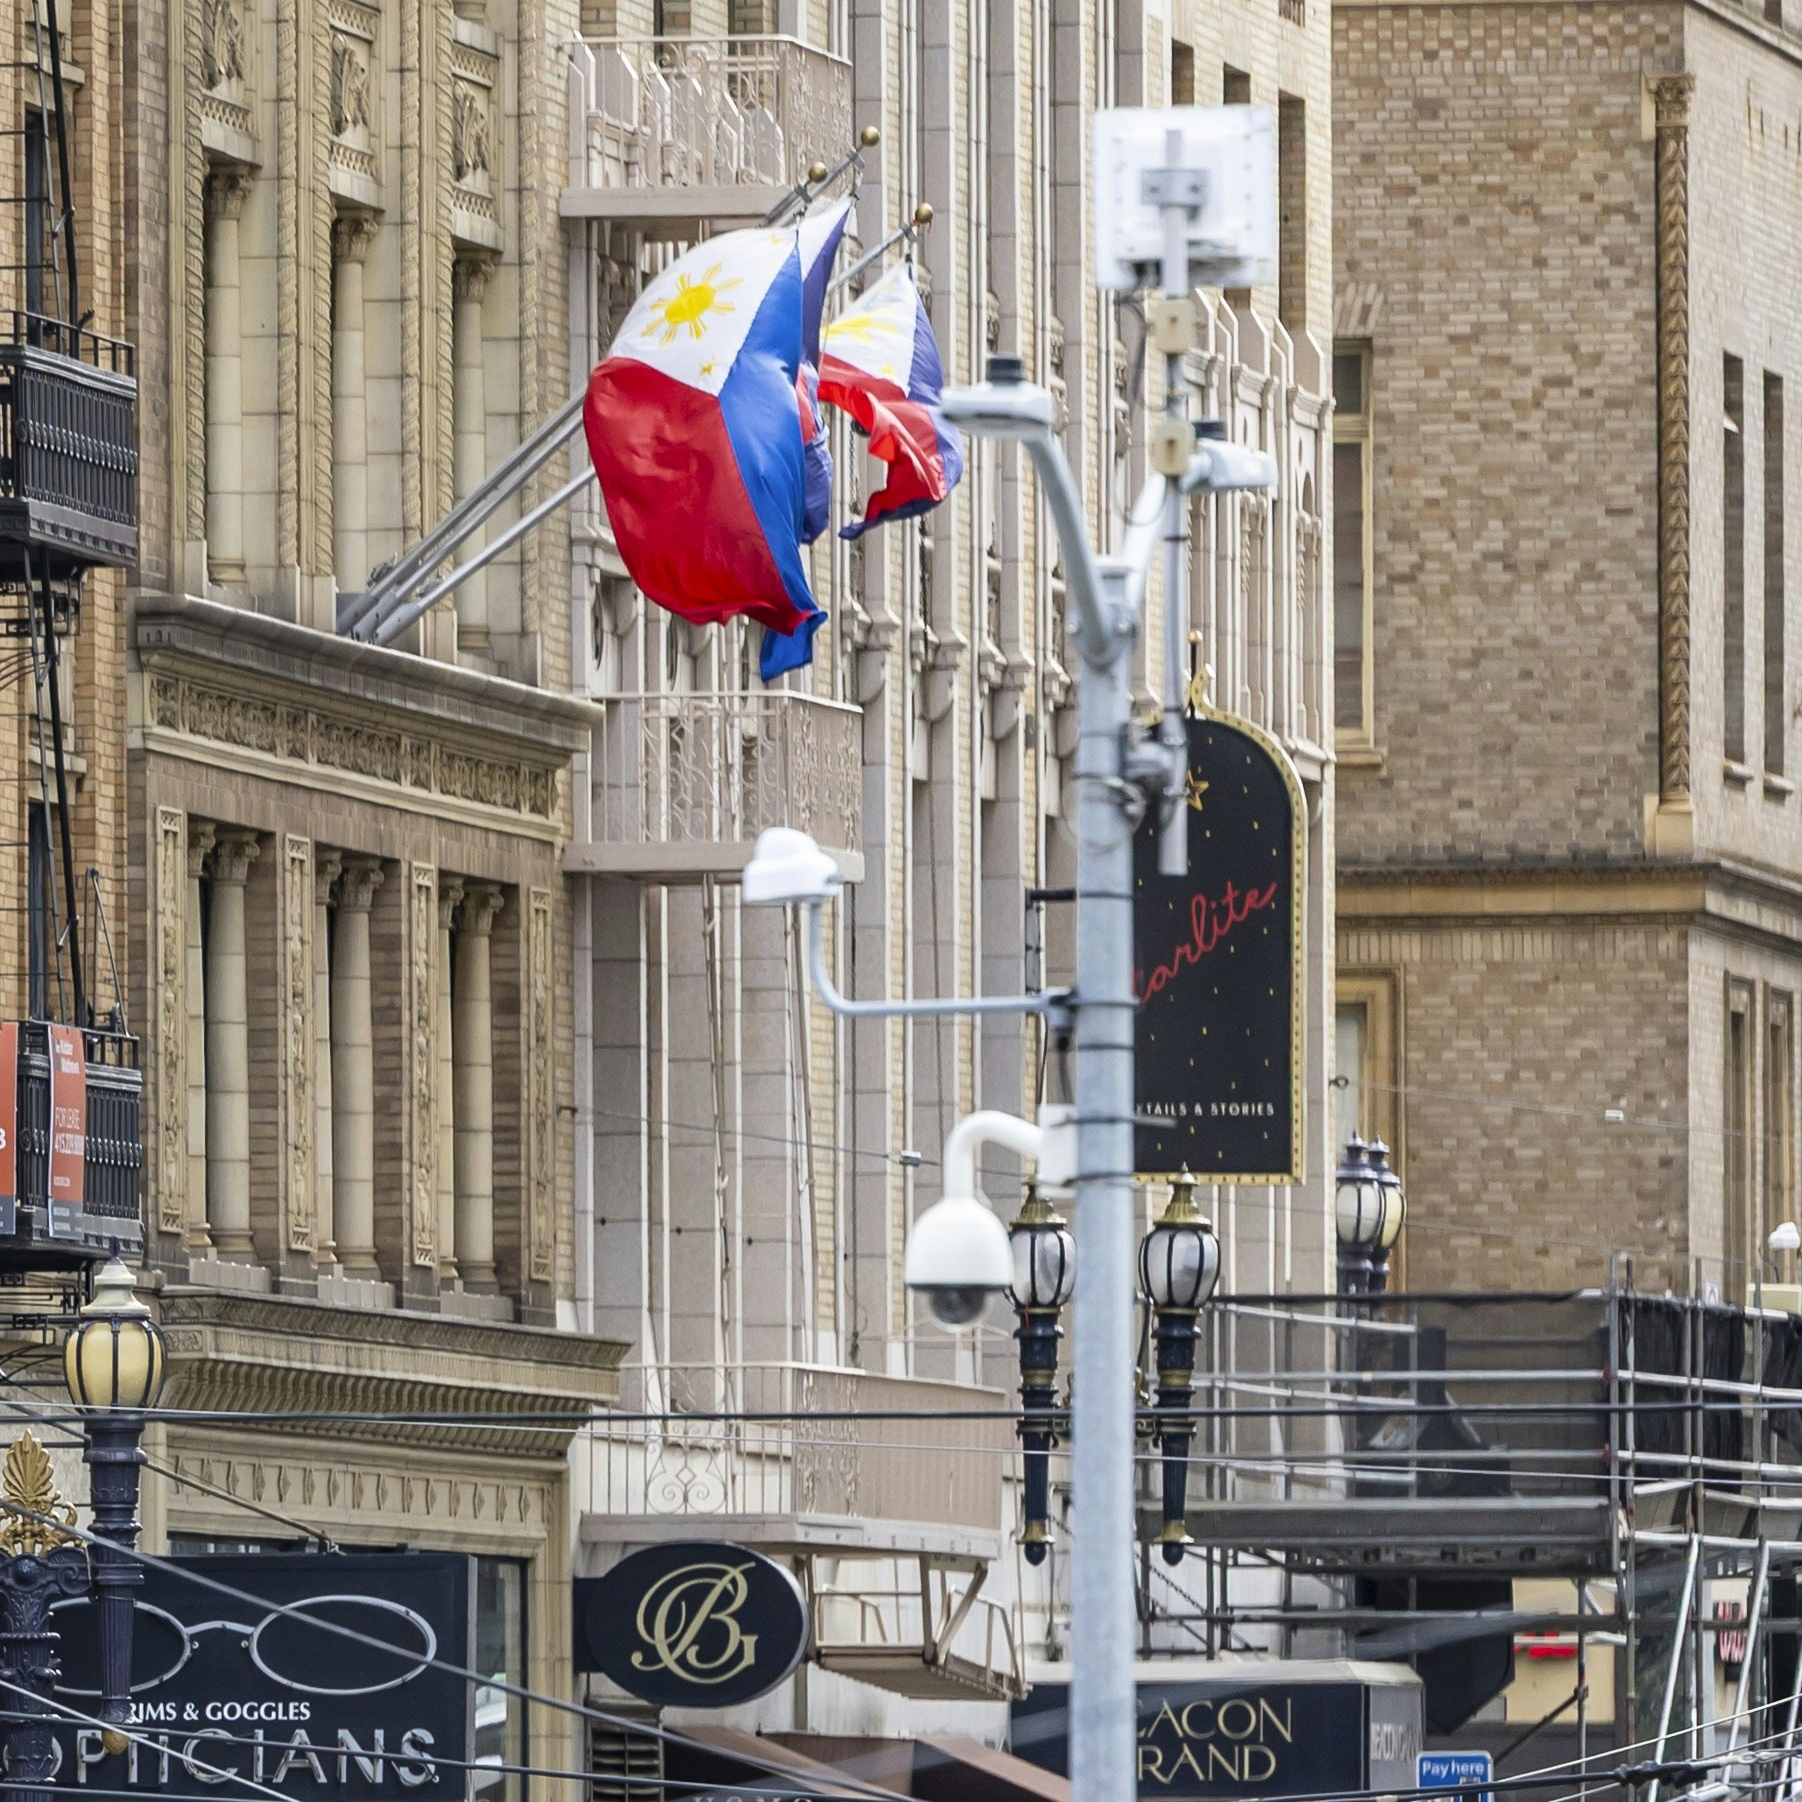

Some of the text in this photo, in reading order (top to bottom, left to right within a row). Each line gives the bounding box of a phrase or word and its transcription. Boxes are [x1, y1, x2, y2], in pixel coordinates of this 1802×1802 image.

[1210, 1102, 1275, 1116] STORIES
[182, 1702, 200, 1722] &
[204, 1702, 312, 1722] GOGGLES
[1138, 1743, 1277, 1784] RAND
[1422, 1760, 1485, 1779] Pay here
